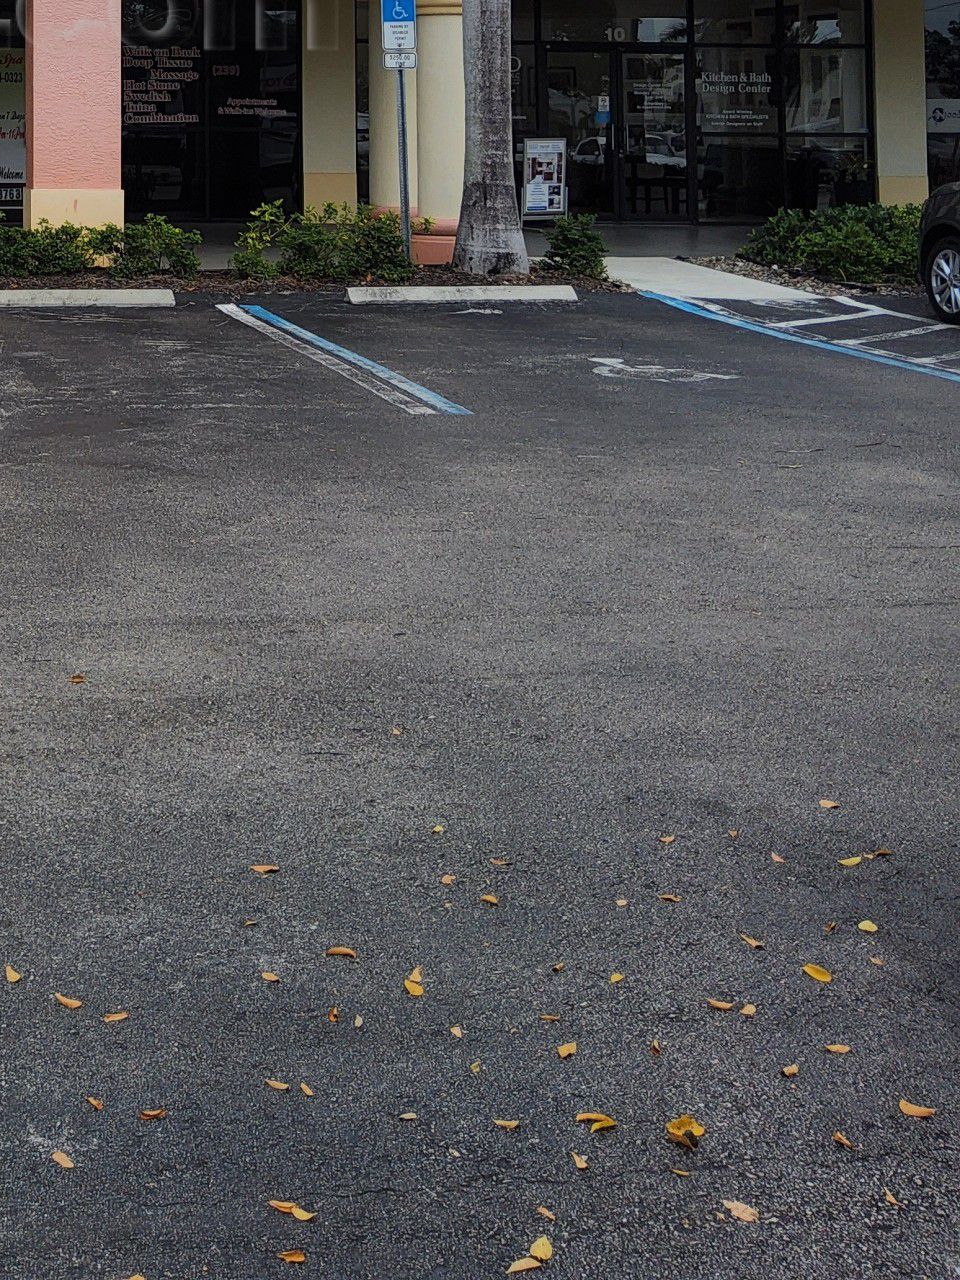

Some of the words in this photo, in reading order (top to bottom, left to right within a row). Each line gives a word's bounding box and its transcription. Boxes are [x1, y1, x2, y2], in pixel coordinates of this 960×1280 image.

[604, 27, 625, 42] 10
[122, 45, 152, 56] Walk
[153, 48, 170, 57] on
[170, 46, 201, 57] Back
[155, 57, 193, 68] Tissue
[150, 68, 200, 81] Massage
[212, 64, 240, 76] (239)
[701, 71, 738, 83] Kitchen
[739, 72, 748, 83] &
[749, 72, 772, 83] Bath
[123, 80, 146, 91] Hot
[702, 83, 735, 95] Design
[738, 83, 772, 94] Center
[123, 90, 172, 102] Swedish
[123, 112, 200, 123] Combination
